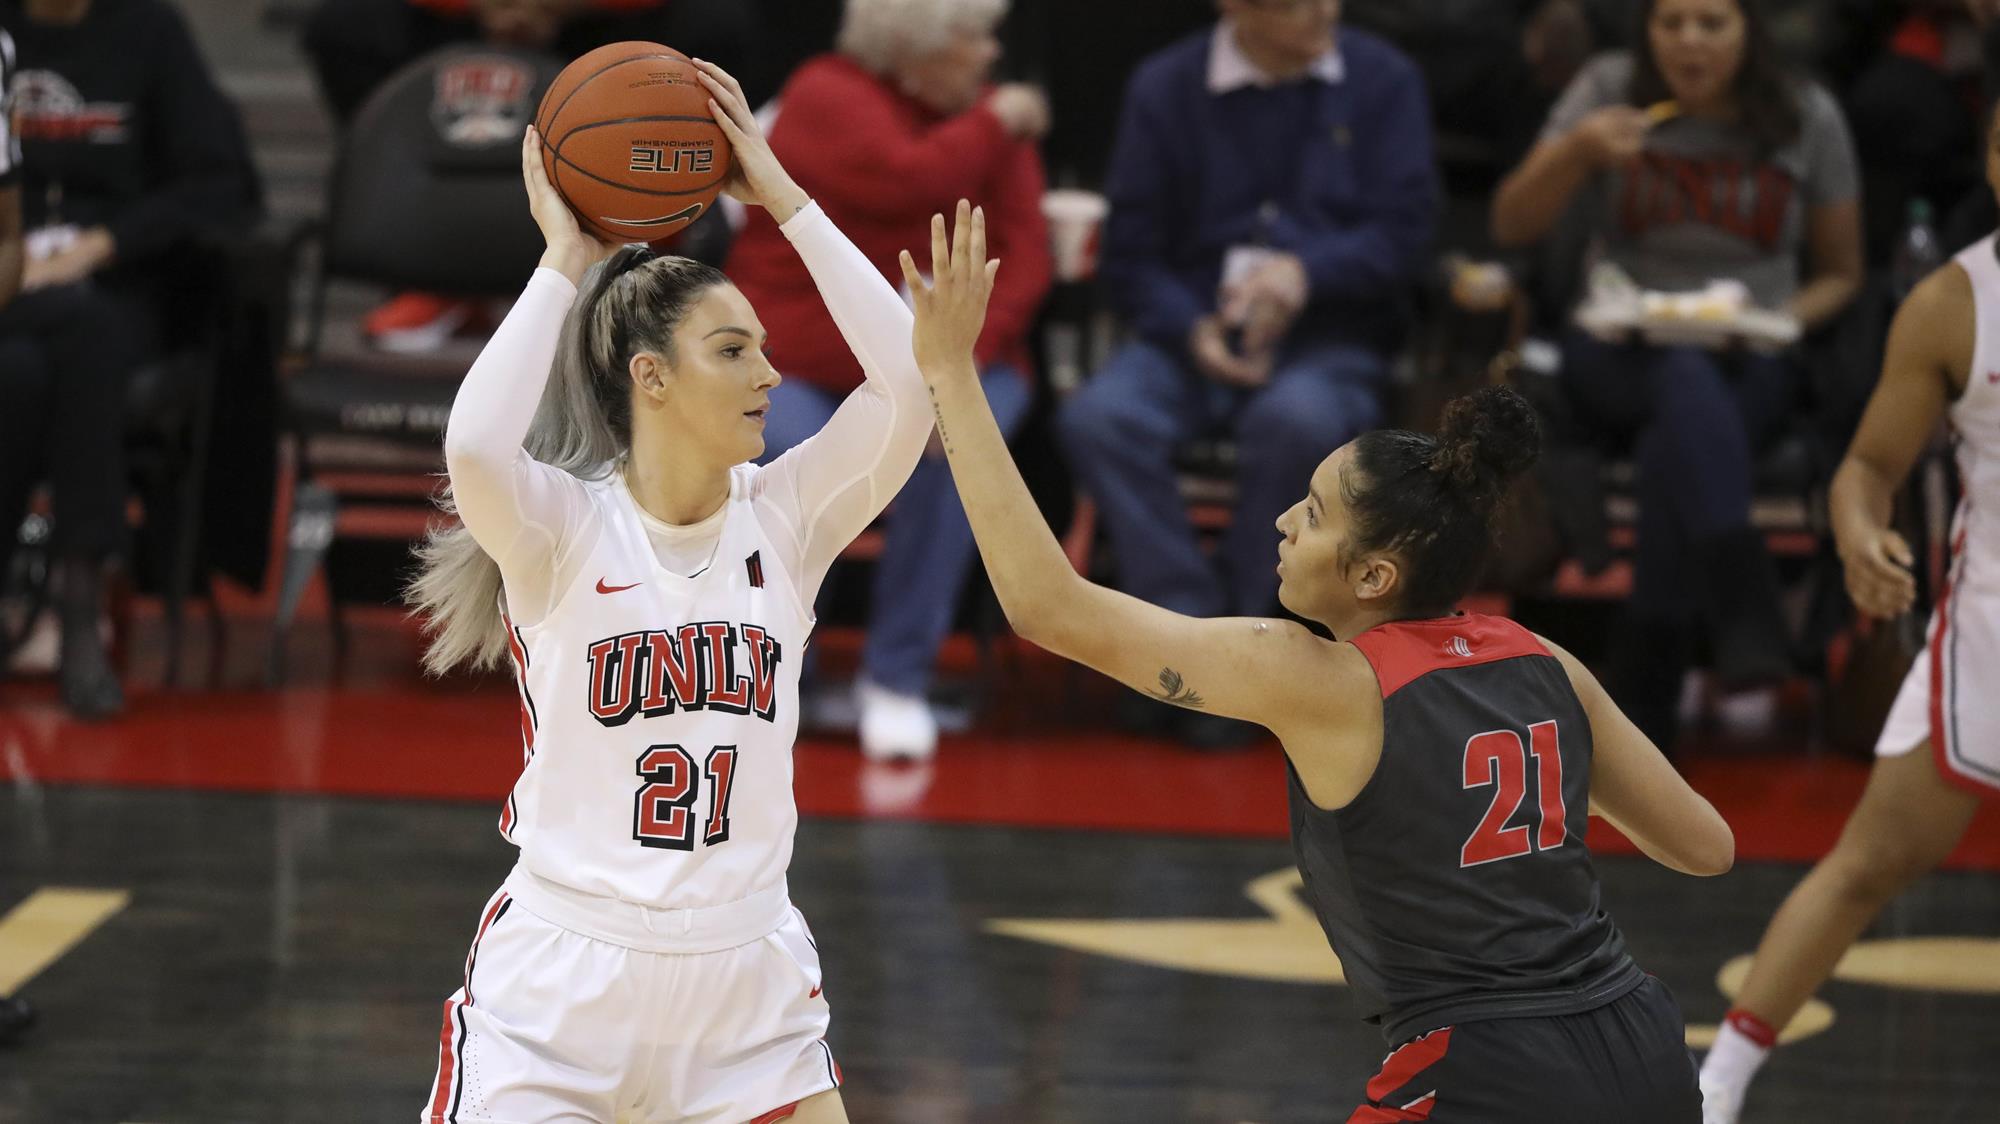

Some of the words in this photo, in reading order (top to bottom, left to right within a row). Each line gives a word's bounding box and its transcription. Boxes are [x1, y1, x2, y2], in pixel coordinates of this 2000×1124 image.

[629, 146, 713, 174] ELITE
[631, 139, 714, 147] CHAMPIONSHIP
[587, 621, 782, 728] UNLV
[632, 743, 738, 852] 21
[1460, 719, 1567, 868] 21
